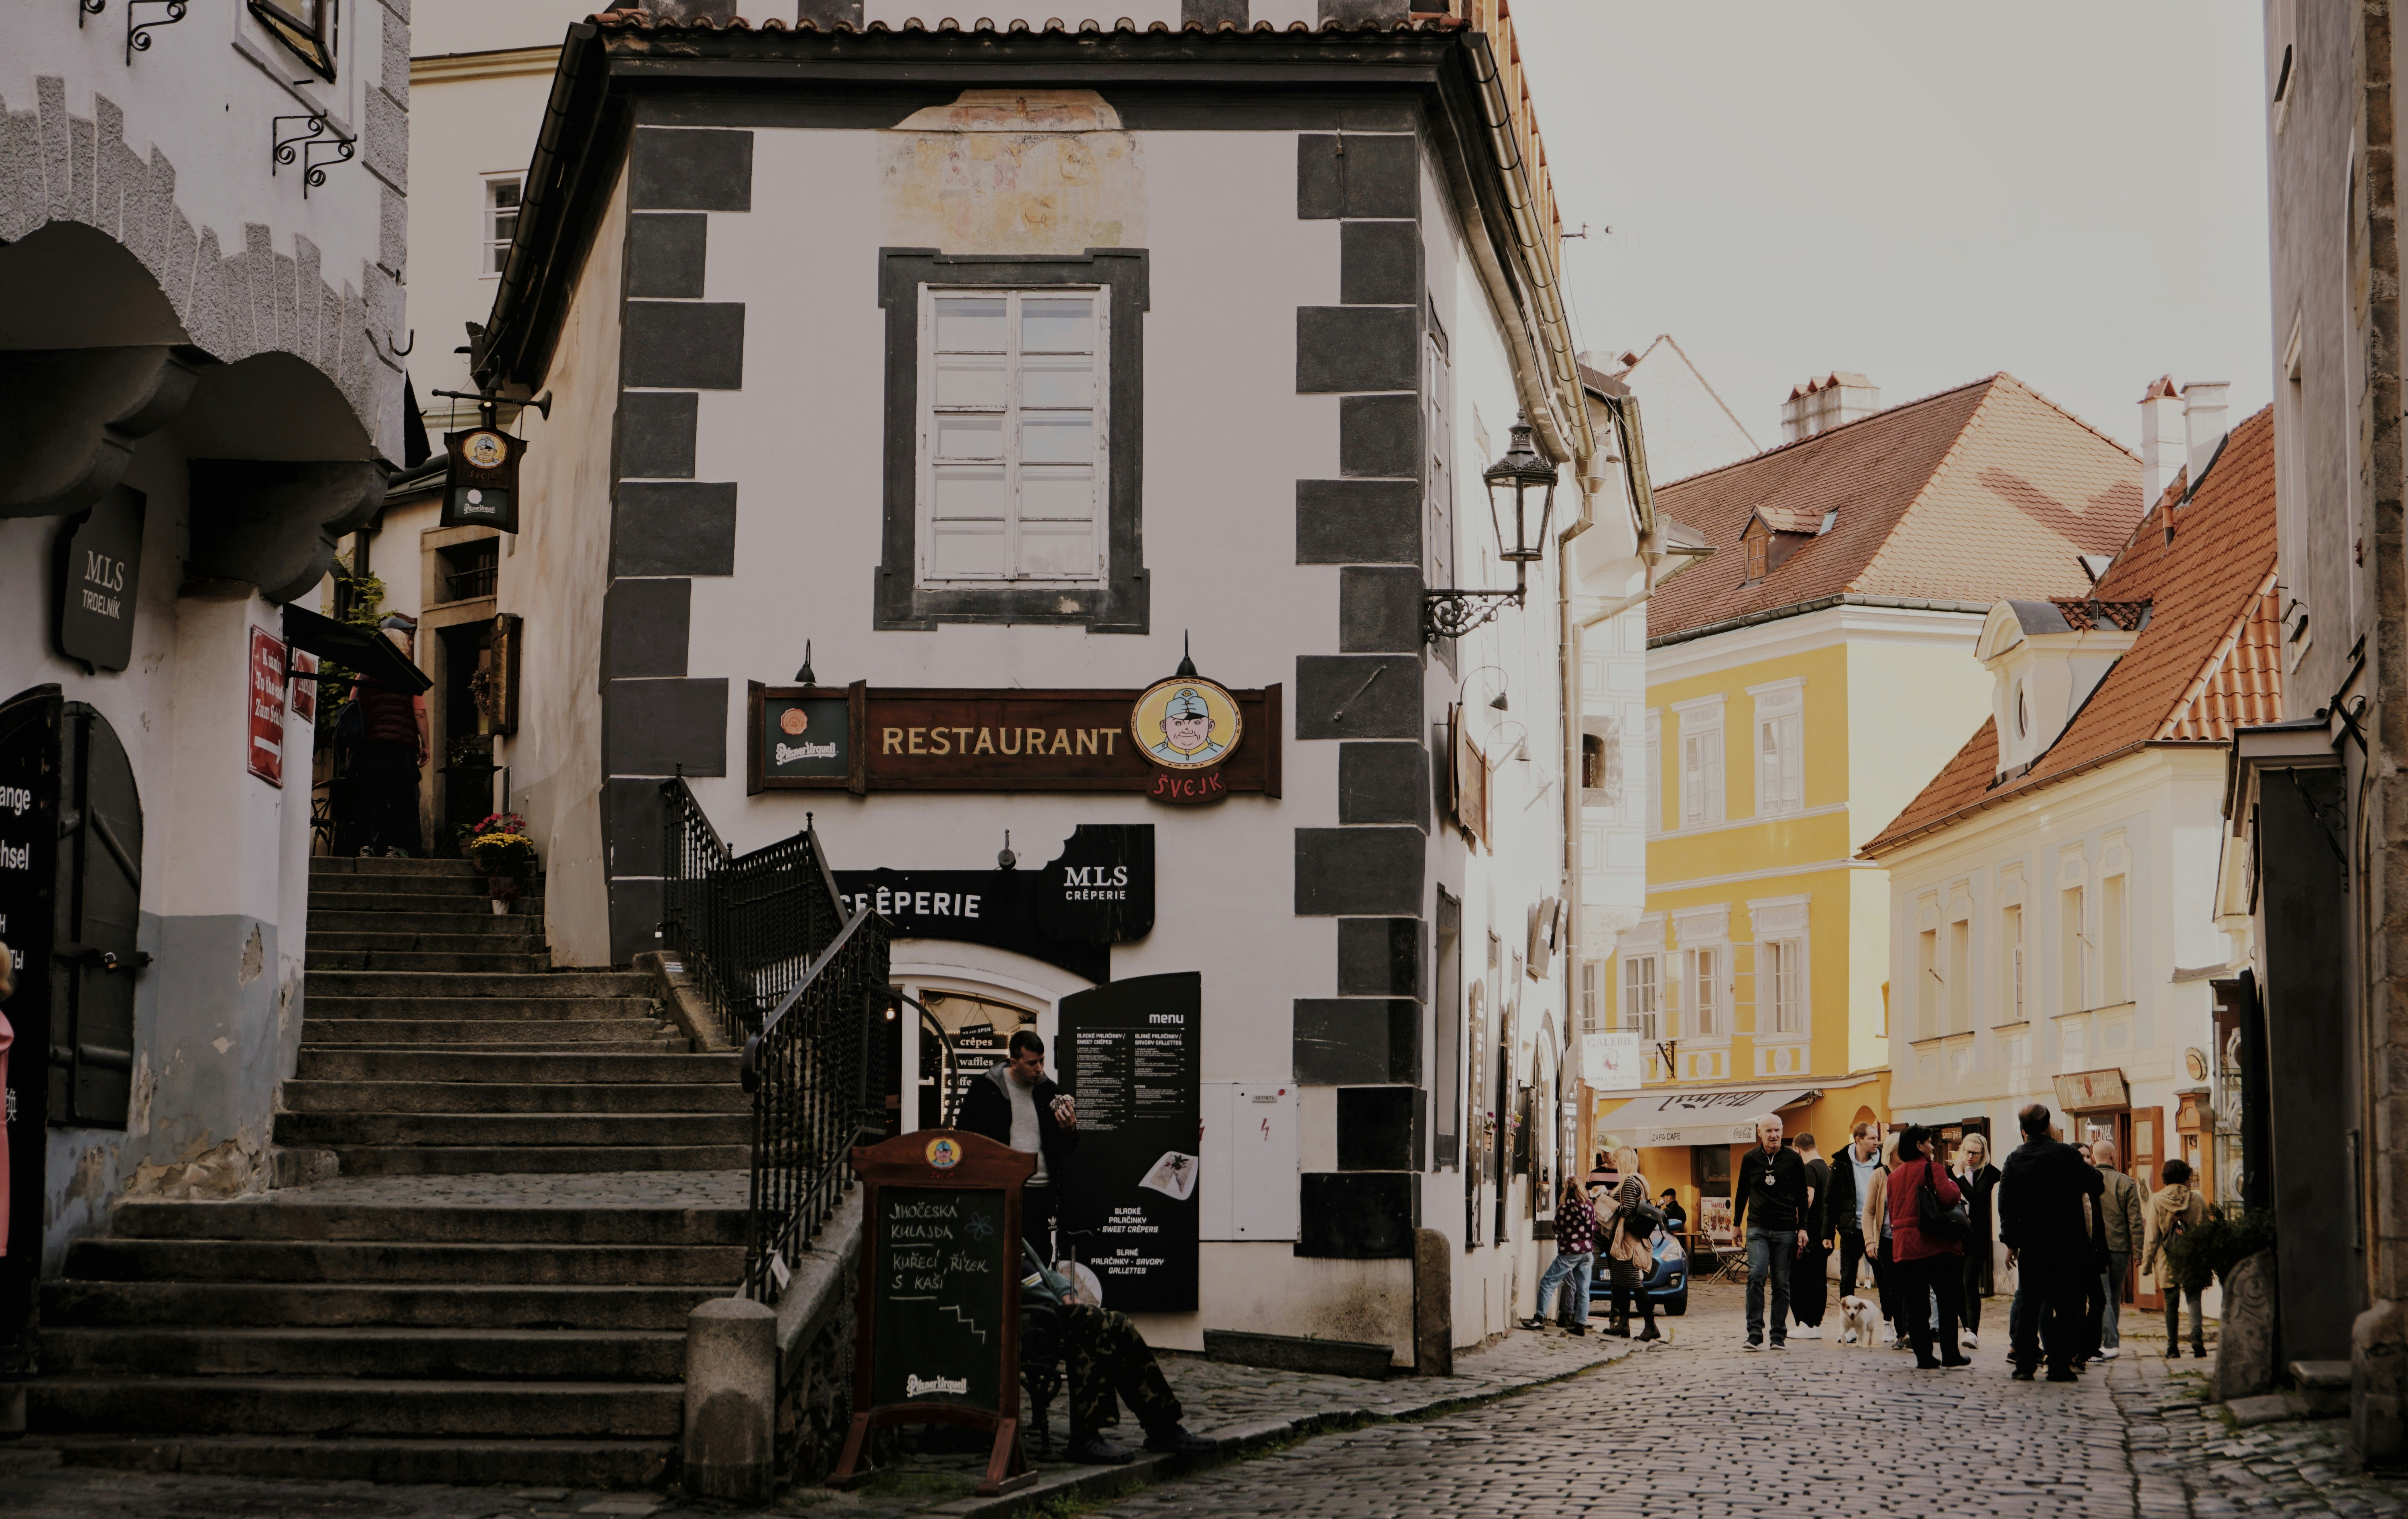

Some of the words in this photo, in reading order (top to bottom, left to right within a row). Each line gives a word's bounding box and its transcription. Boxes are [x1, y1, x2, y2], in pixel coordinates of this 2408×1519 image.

[468, 469, 497, 479] ŠVEJK
[464, 503, 480, 514] Pilsner
[480, 504, 495, 513] Urquell
[84, 550, 124, 591] MLS
[83, 589, 120, 619] TRDELNÍK
[262, 647, 268, 666] K
[268, 650, 282, 675] zámku
[256, 671, 264, 691] To
[266, 676, 275, 695] the
[255, 698, 269, 720] Zum
[883, 727, 1122, 755] RESTAURANT
[776, 742, 806, 765] Pilsner
[805, 741, 836, 758] Urquell
[1153, 772, 1223, 798] ŠVEJK
[0, 840, 29, 870] hsel
[1064, 866, 1127, 886] MLS
[1066, 888, 1125, 900] CRÊPERIE
[1149, 1014, 1184, 1023] menu
[960, 1037, 992, 1048] crêpes
[1588, 1037, 1633, 1047] GALERIE
[959, 1057, 993, 1066] waffles
[1652, 1133, 1665, 1141] ZAPA
[1667, 1132, 1680, 1140] CAFE
[889, 1197, 959, 1219] JIHOČESKÁ
[1115, 1206, 1141, 1215] SLADKÉ
[1109, 1215, 1147, 1224] PALAČINKY
[891, 1225, 953, 1240] KULAJDA
[1127, 1225, 1159, 1233] CRÊPERS
[1117, 1248, 1139, 1256] SLANÉ
[1091, 1257, 1129, 1265] PALAČINKY
[891, 1274, 903, 1289] S
[915, 1267, 947, 1290] KAŠÍ
[907, 1374, 938, 1398] Pilsner
[937, 1375, 968, 1393] Urquell
